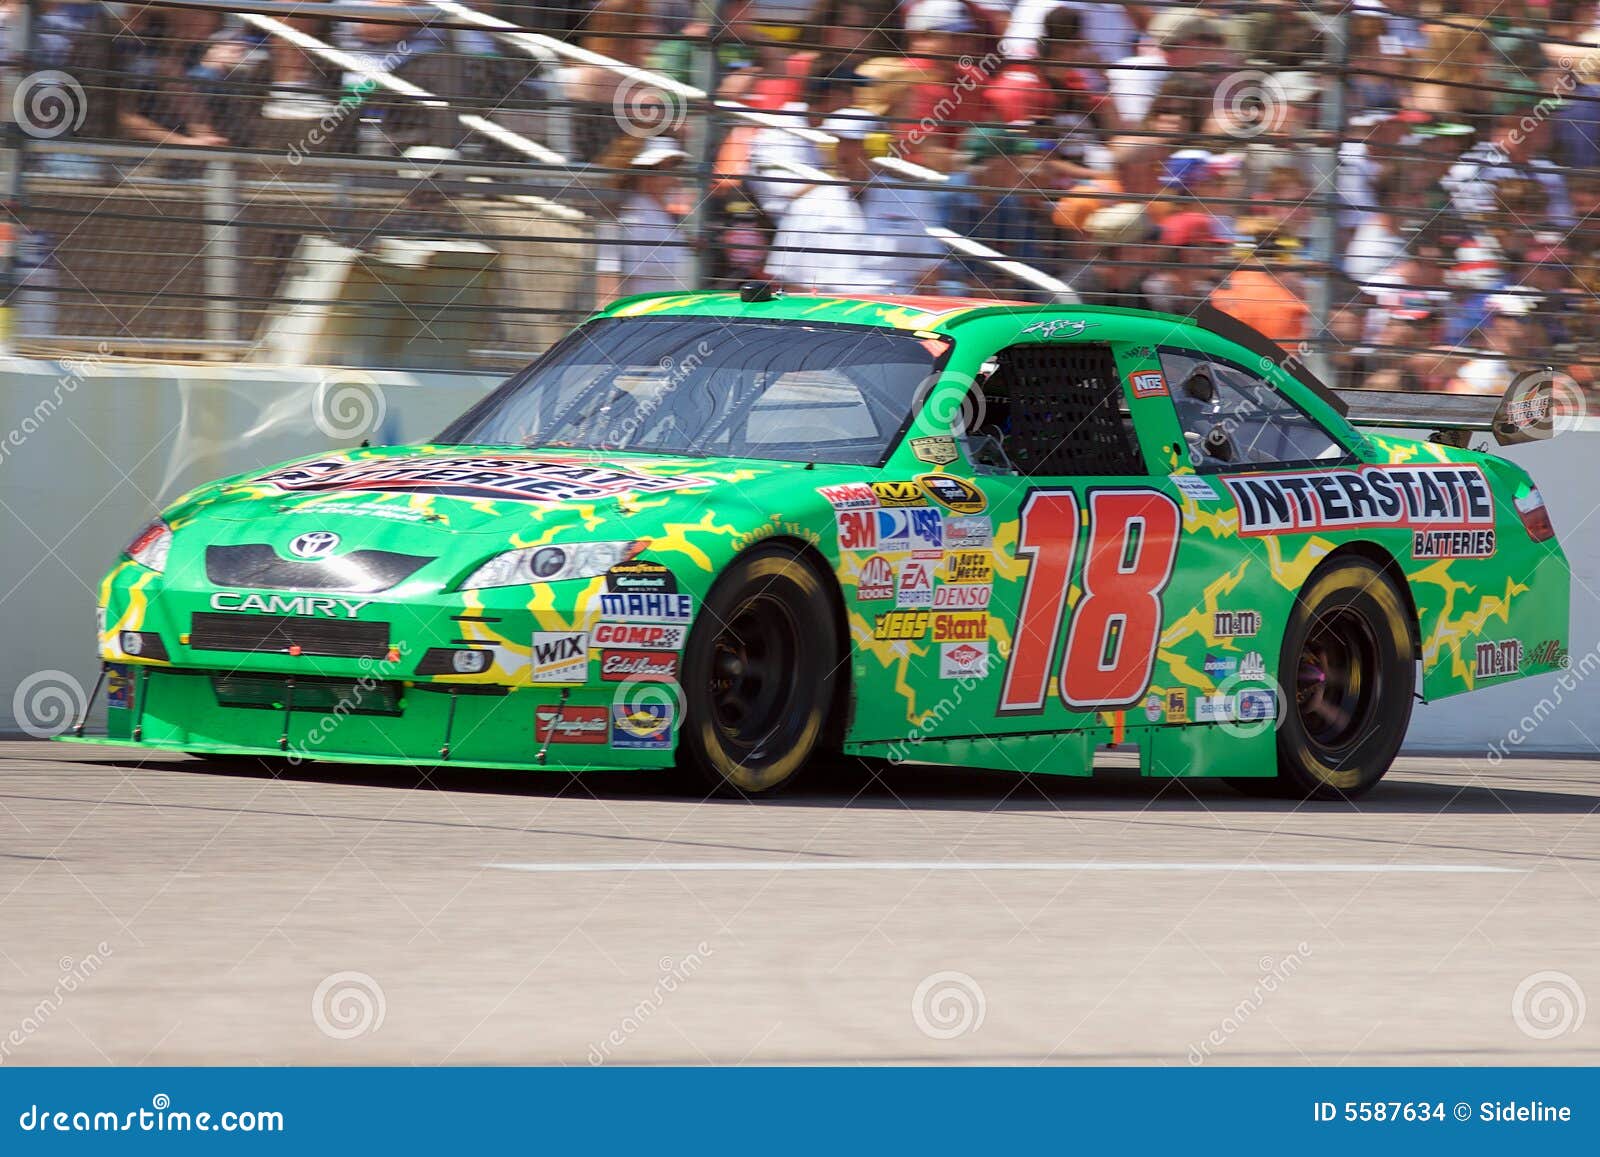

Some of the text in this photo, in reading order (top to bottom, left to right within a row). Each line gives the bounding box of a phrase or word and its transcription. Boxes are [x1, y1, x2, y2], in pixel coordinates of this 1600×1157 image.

[1133, 374, 1163, 391] NOS
[1229, 471, 1491, 527] INTERSTATE
[840, 512, 876, 548] 3M
[1415, 531, 1494, 556] BATTERIES
[958, 553, 985, 566] Auto
[900, 563, 930, 590] EA
[956, 566, 990, 578] Meter
[210, 592, 375, 618] CAMRY
[858, 587, 893, 600] TOOLS
[899, 591, 931, 603] SPORTS
[934, 587, 990, 606] DENSO
[998, 488, 1181, 714] 18
[600, 594, 691, 618] MAHLE
[595, 625, 664, 643] COMP
[875, 610, 930, 640] JEGS
[934, 613, 988, 640] Stant
[535, 634, 584, 665] WIX
[602, 656, 677, 677] Edelbrock
[1240, 673, 1265, 681] TOOLS
